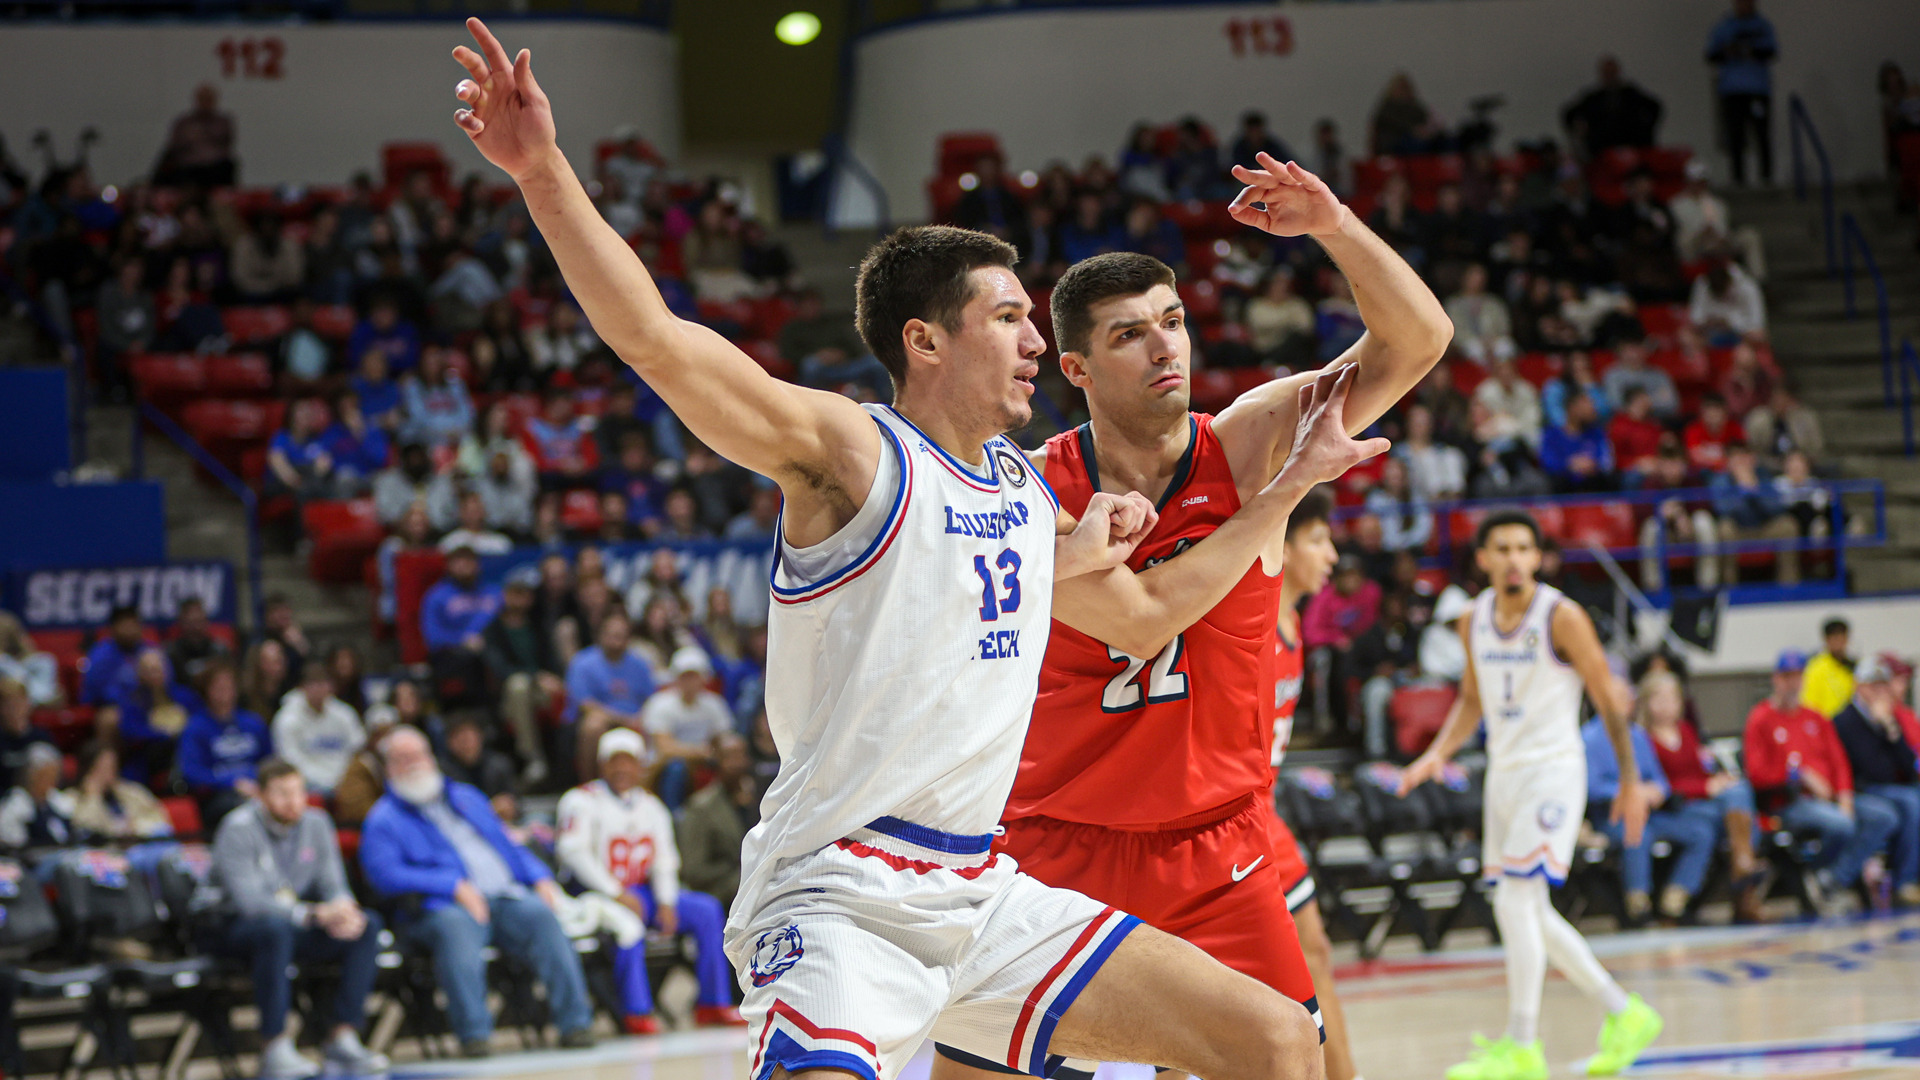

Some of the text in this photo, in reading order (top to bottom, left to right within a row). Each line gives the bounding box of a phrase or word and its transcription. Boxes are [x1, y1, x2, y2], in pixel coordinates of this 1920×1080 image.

[217, 38, 286, 79] 112
[1223, 18, 1295, 57] 113
[26, 566, 224, 624] SECTION
[973, 547, 1022, 622] 13
[971, 629, 1020, 660] ECH
[1101, 633, 1189, 713] 22
